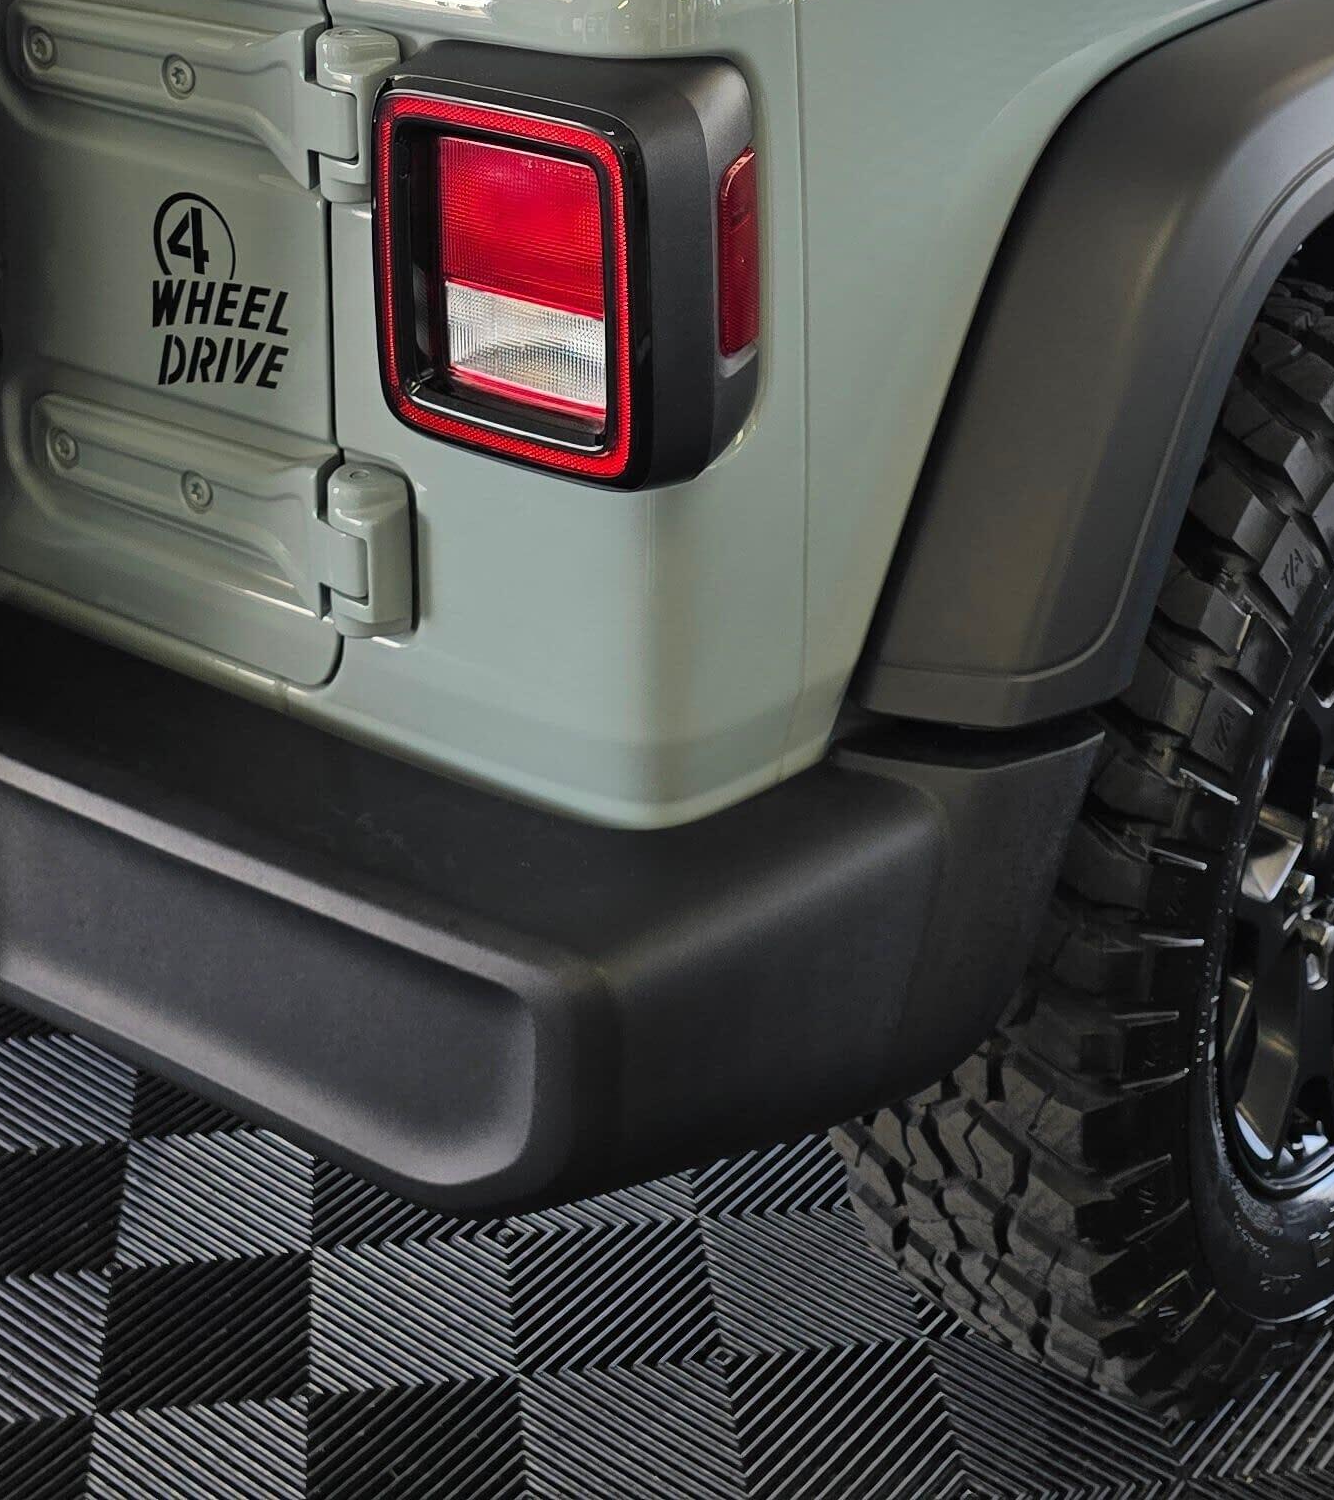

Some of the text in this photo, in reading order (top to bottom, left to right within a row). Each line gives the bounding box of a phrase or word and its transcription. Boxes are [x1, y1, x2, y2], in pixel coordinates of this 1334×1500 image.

[167, 206, 209, 275] 4
[152, 279, 289, 337] WHEEL
[158, 334, 289, 389] DRIVE
